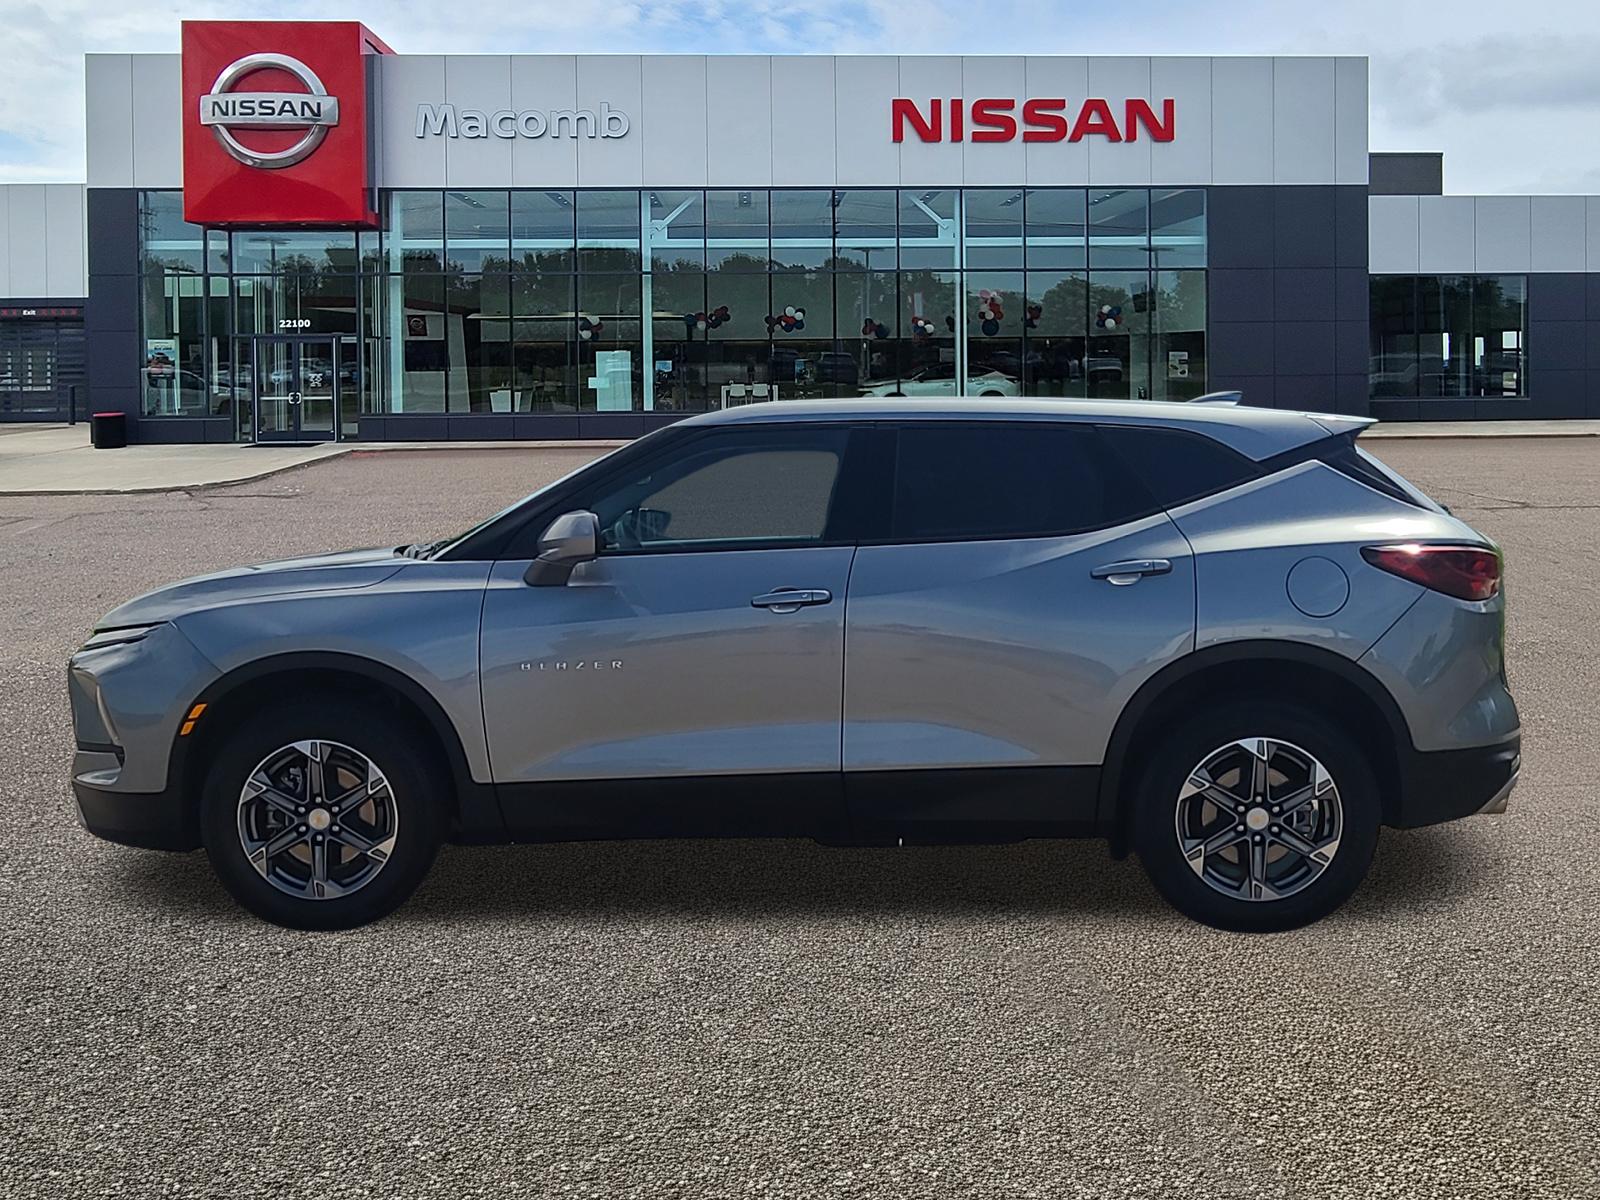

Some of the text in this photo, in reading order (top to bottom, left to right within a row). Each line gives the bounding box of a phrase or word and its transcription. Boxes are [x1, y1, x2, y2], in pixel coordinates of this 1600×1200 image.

[211, 100, 322, 118] NISSAN
[415, 102, 630, 139] Macomb
[892, 98, 1176, 143] NISSAN
[279, 319, 311, 328] 22100
[520, 660, 623, 671] BLAZER
